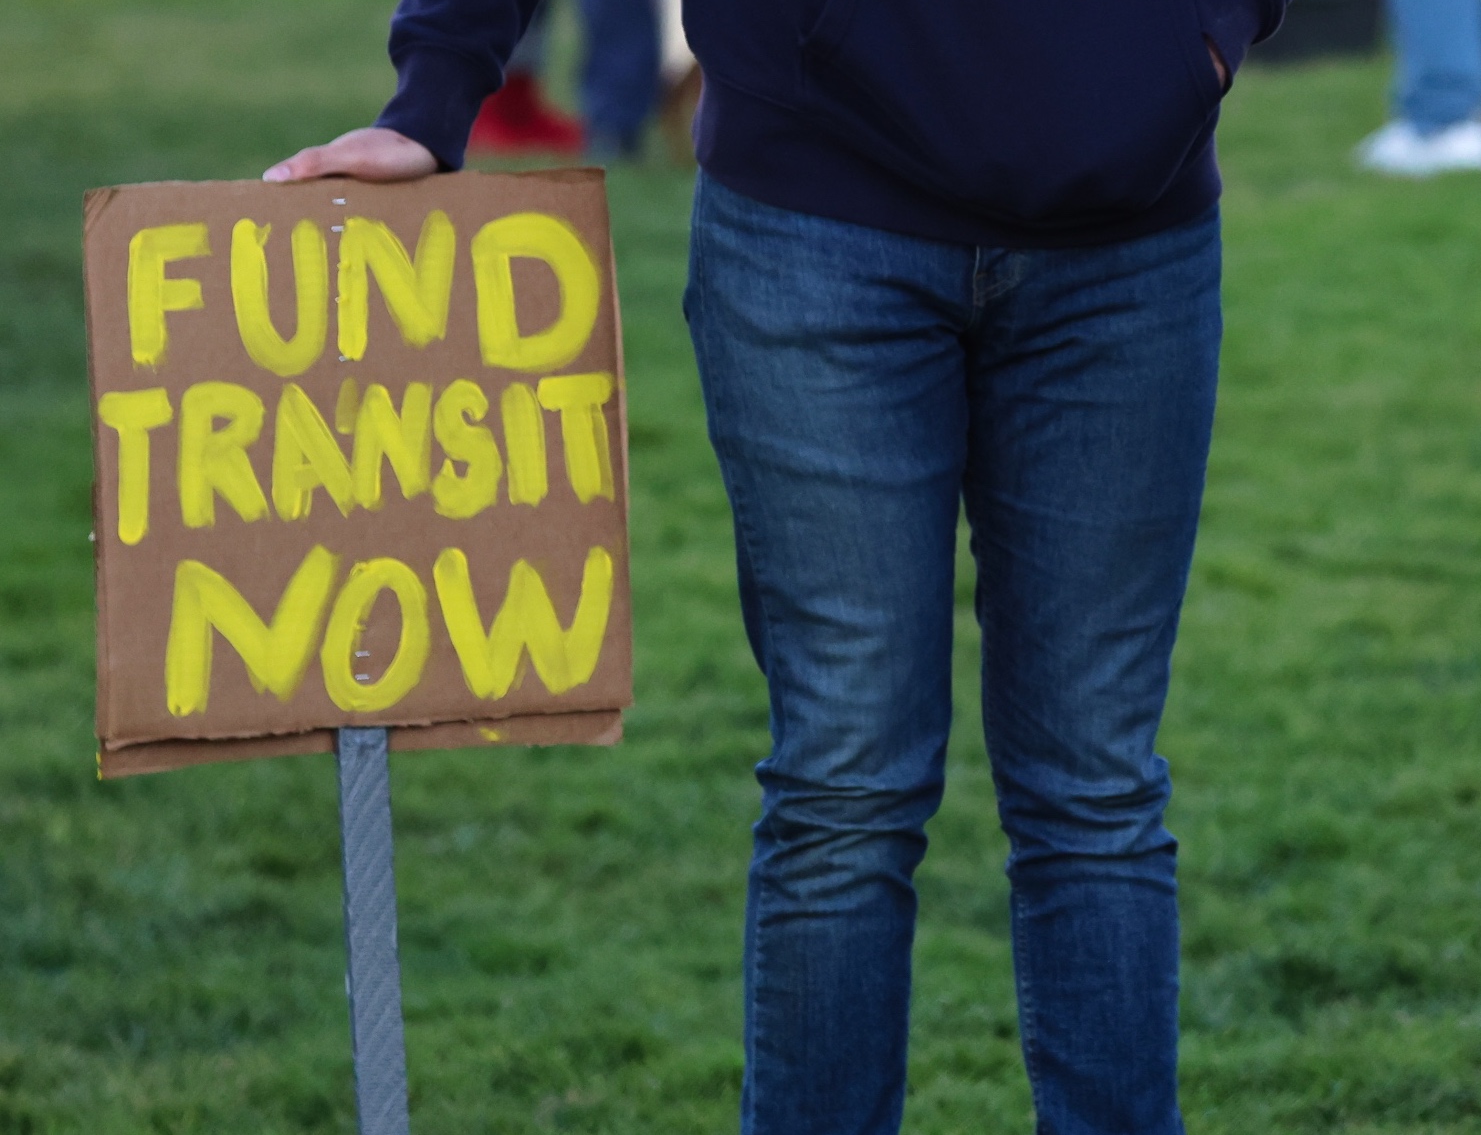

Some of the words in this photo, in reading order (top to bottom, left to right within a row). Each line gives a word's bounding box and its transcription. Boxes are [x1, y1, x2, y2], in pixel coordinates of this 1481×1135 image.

[127, 209, 600, 377] FUND
[99, 372, 615, 545] TRANSIT
[164, 543, 613, 717] NOW
